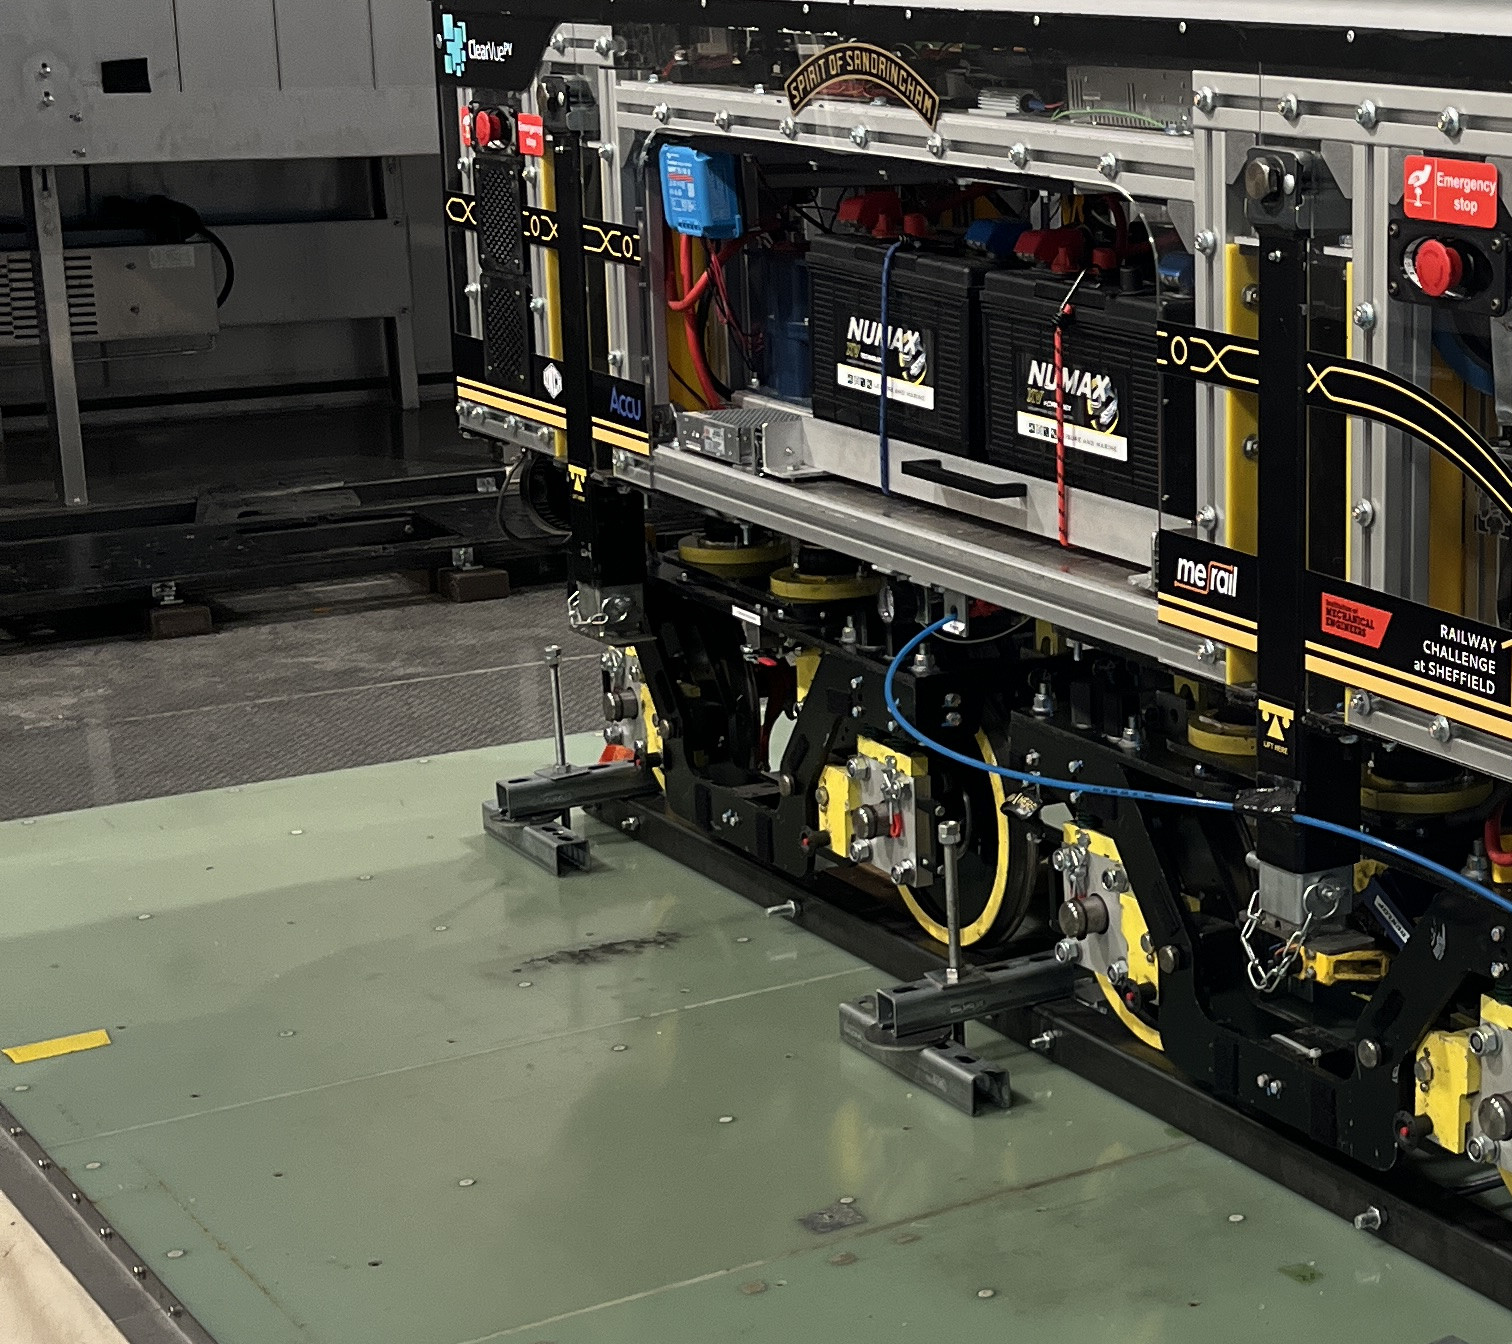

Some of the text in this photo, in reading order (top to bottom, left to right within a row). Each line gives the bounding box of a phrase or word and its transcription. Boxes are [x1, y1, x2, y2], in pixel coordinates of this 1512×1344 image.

[789, 49, 934, 118] SPIRIT OF SANDRINGHAM
[1436, 171, 1497, 197] Emergency
[1453, 197, 1478, 216] stop
[847, 316, 920, 355] NUMAX
[1027, 359, 1110, 402] NUMAX
[1440, 623, 1498, 654] RAILWAY
[1423, 640, 1496, 675] CHALLENGE
[1413, 659, 1496, 695] at SHEFFIELD
